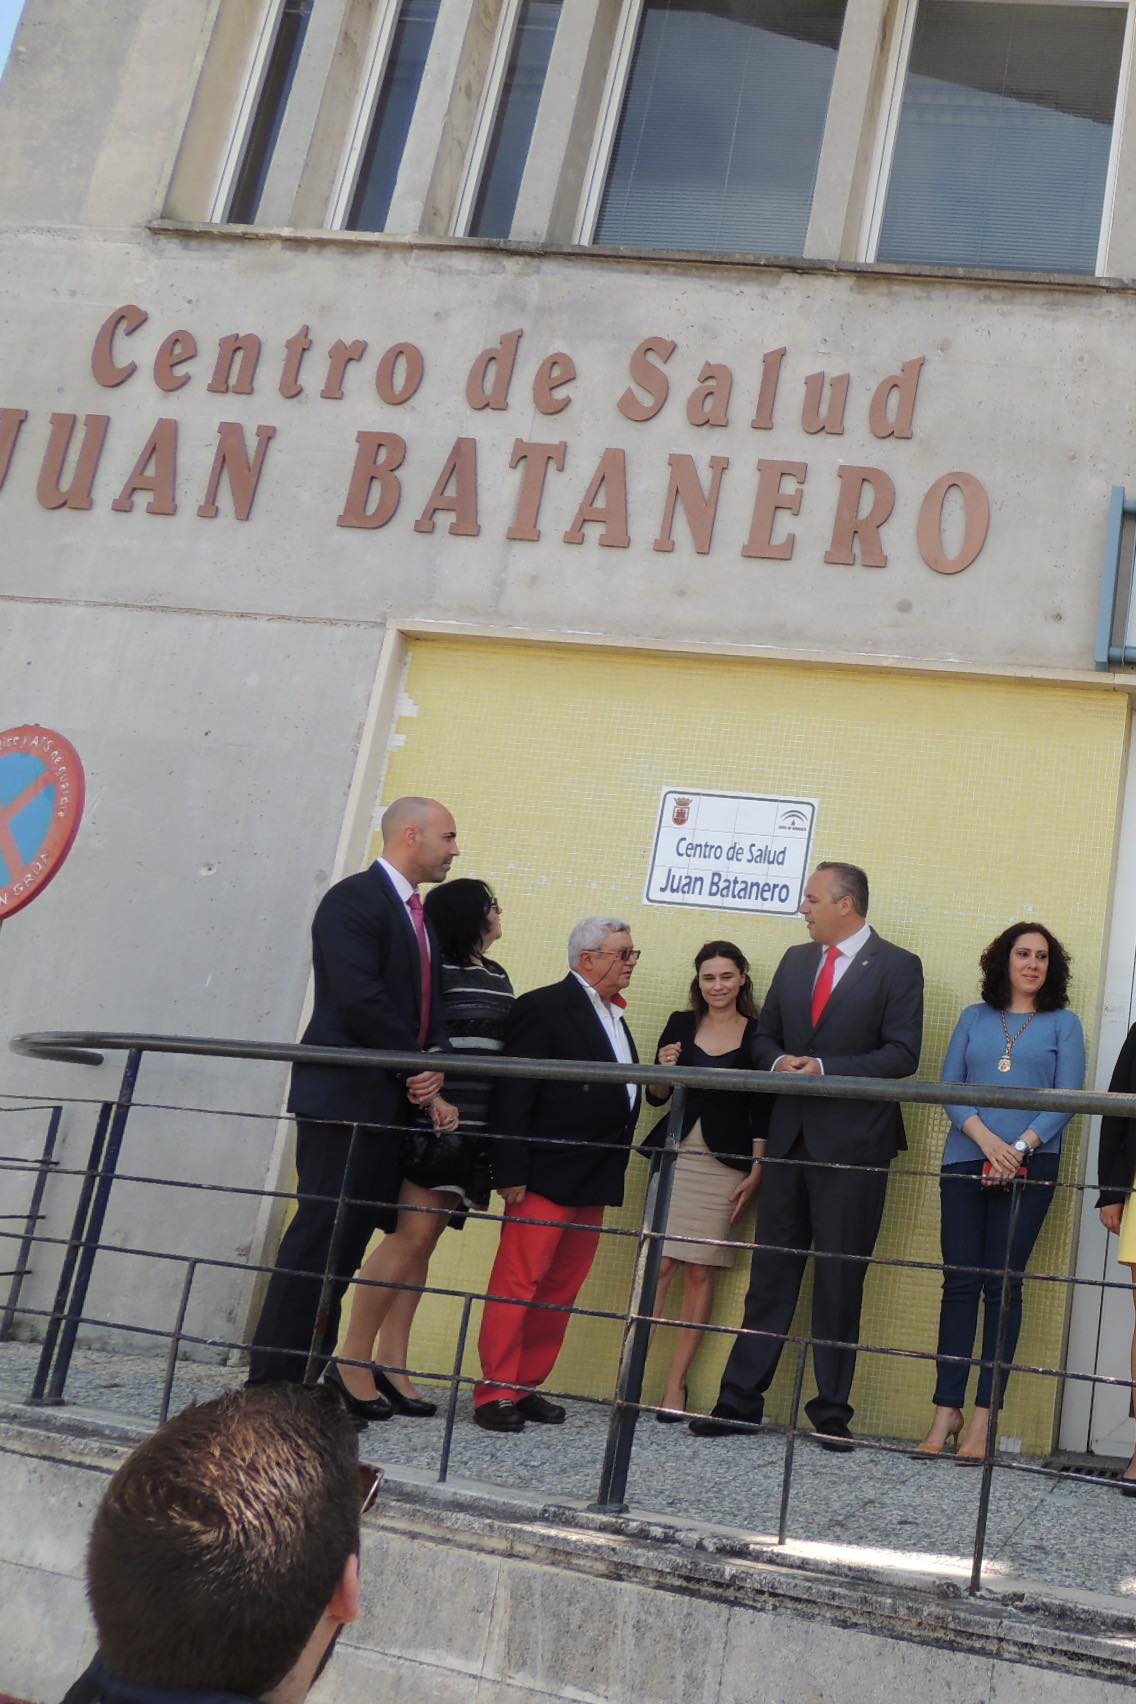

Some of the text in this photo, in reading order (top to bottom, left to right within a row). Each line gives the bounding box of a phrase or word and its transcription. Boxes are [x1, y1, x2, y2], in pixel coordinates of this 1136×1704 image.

[91, 304, 926, 440] Centro de Salud
[336, 430, 990, 575] BATANERO
[660, 868, 790, 903] Juan Batanero
[676, 837, 787, 866] Centro de Salud
